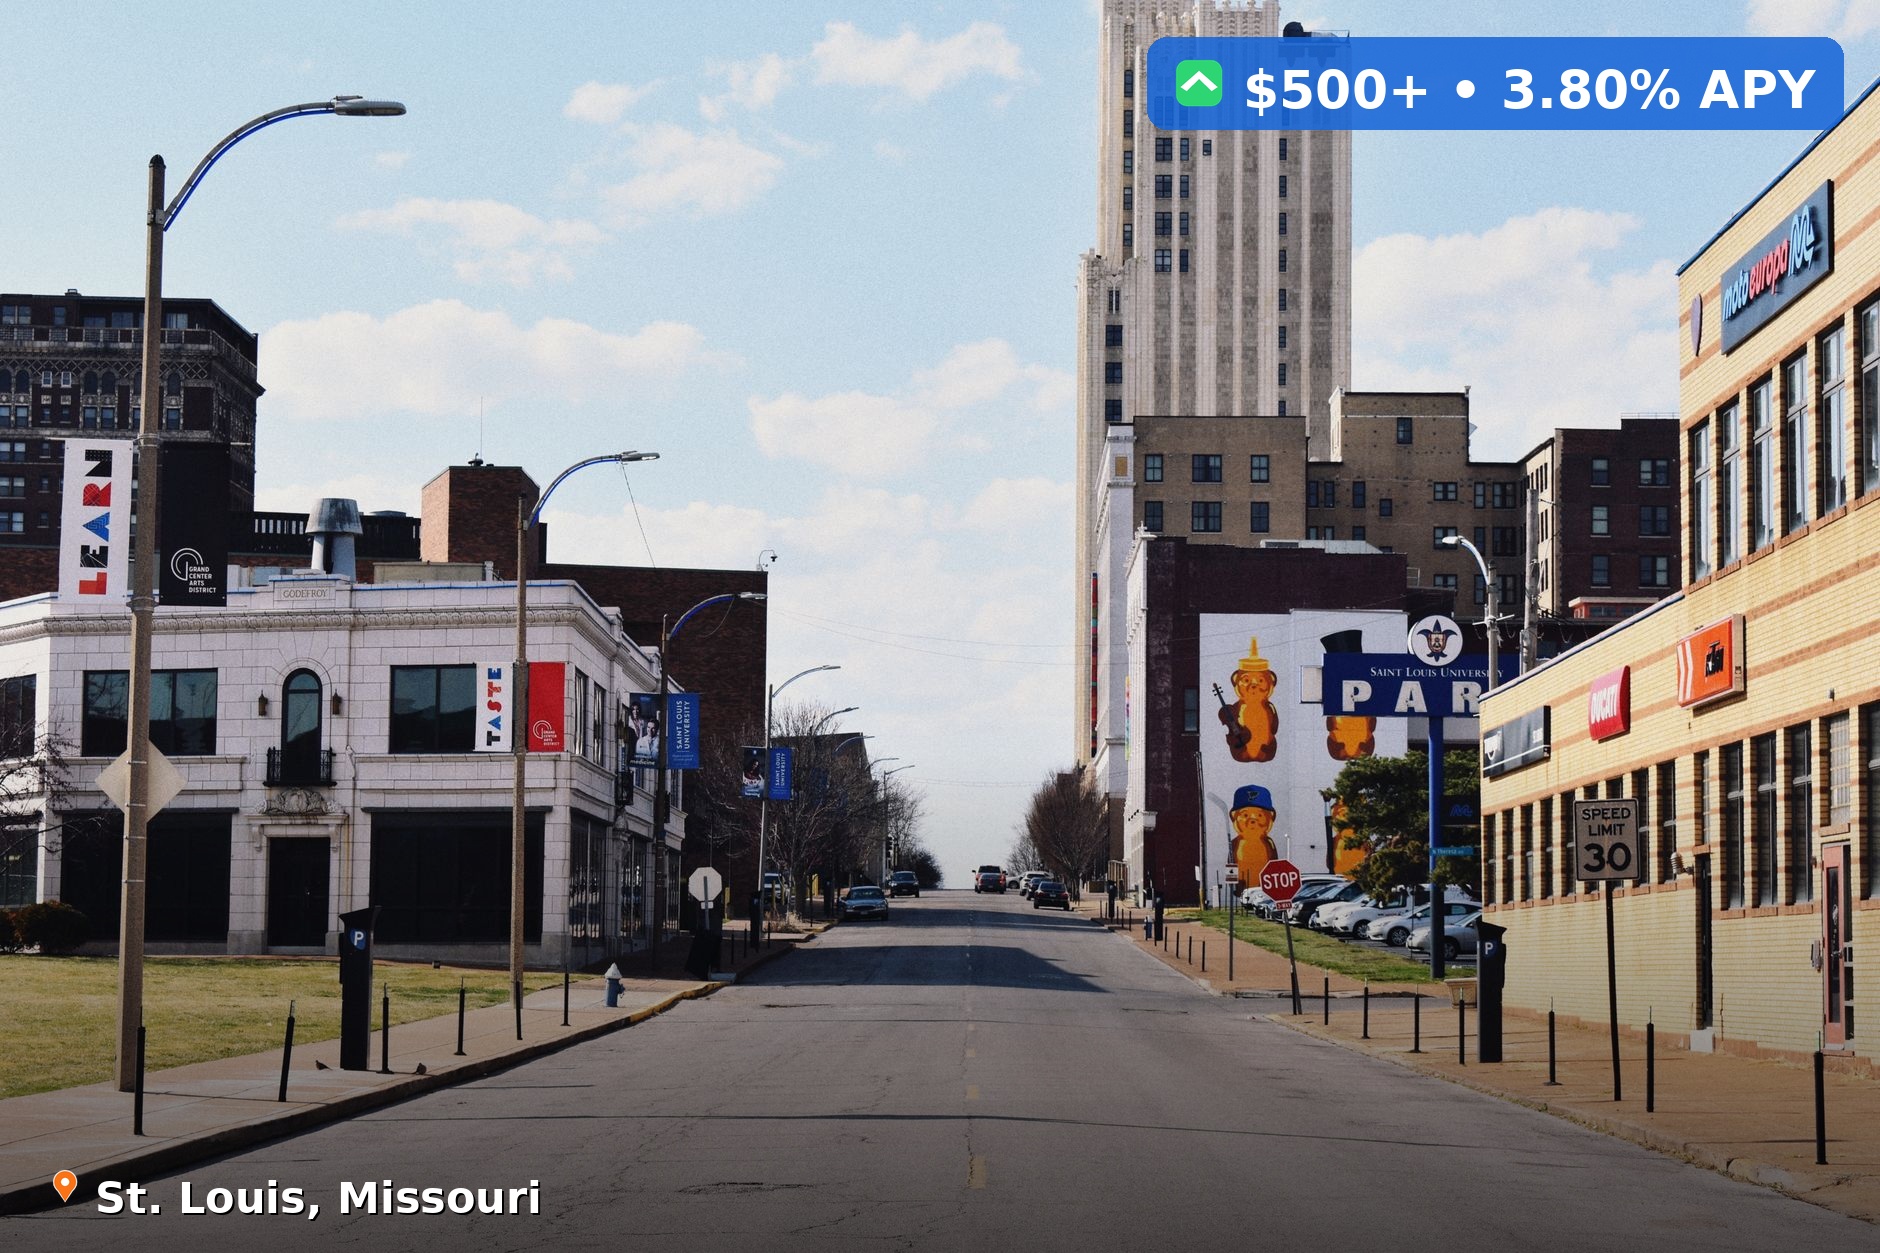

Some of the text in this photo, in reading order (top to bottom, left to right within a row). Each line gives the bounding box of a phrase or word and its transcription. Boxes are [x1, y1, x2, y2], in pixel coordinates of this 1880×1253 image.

[79, 449, 113, 595] LEARN
[283, 589, 328, 598] GODEFROY
[1370, 667, 1504, 679] SAINT LOUIS UNIVERSIY
[486, 668, 502, 746] TASTE
[1582, 807, 1631, 821] SPEED
[1588, 823, 1625, 837] LIMIT
[1583, 842, 1632, 873] 30
[1263, 871, 1298, 890] STOP
[354, 931, 364, 946] P
[1484, 942, 1494, 955] P
